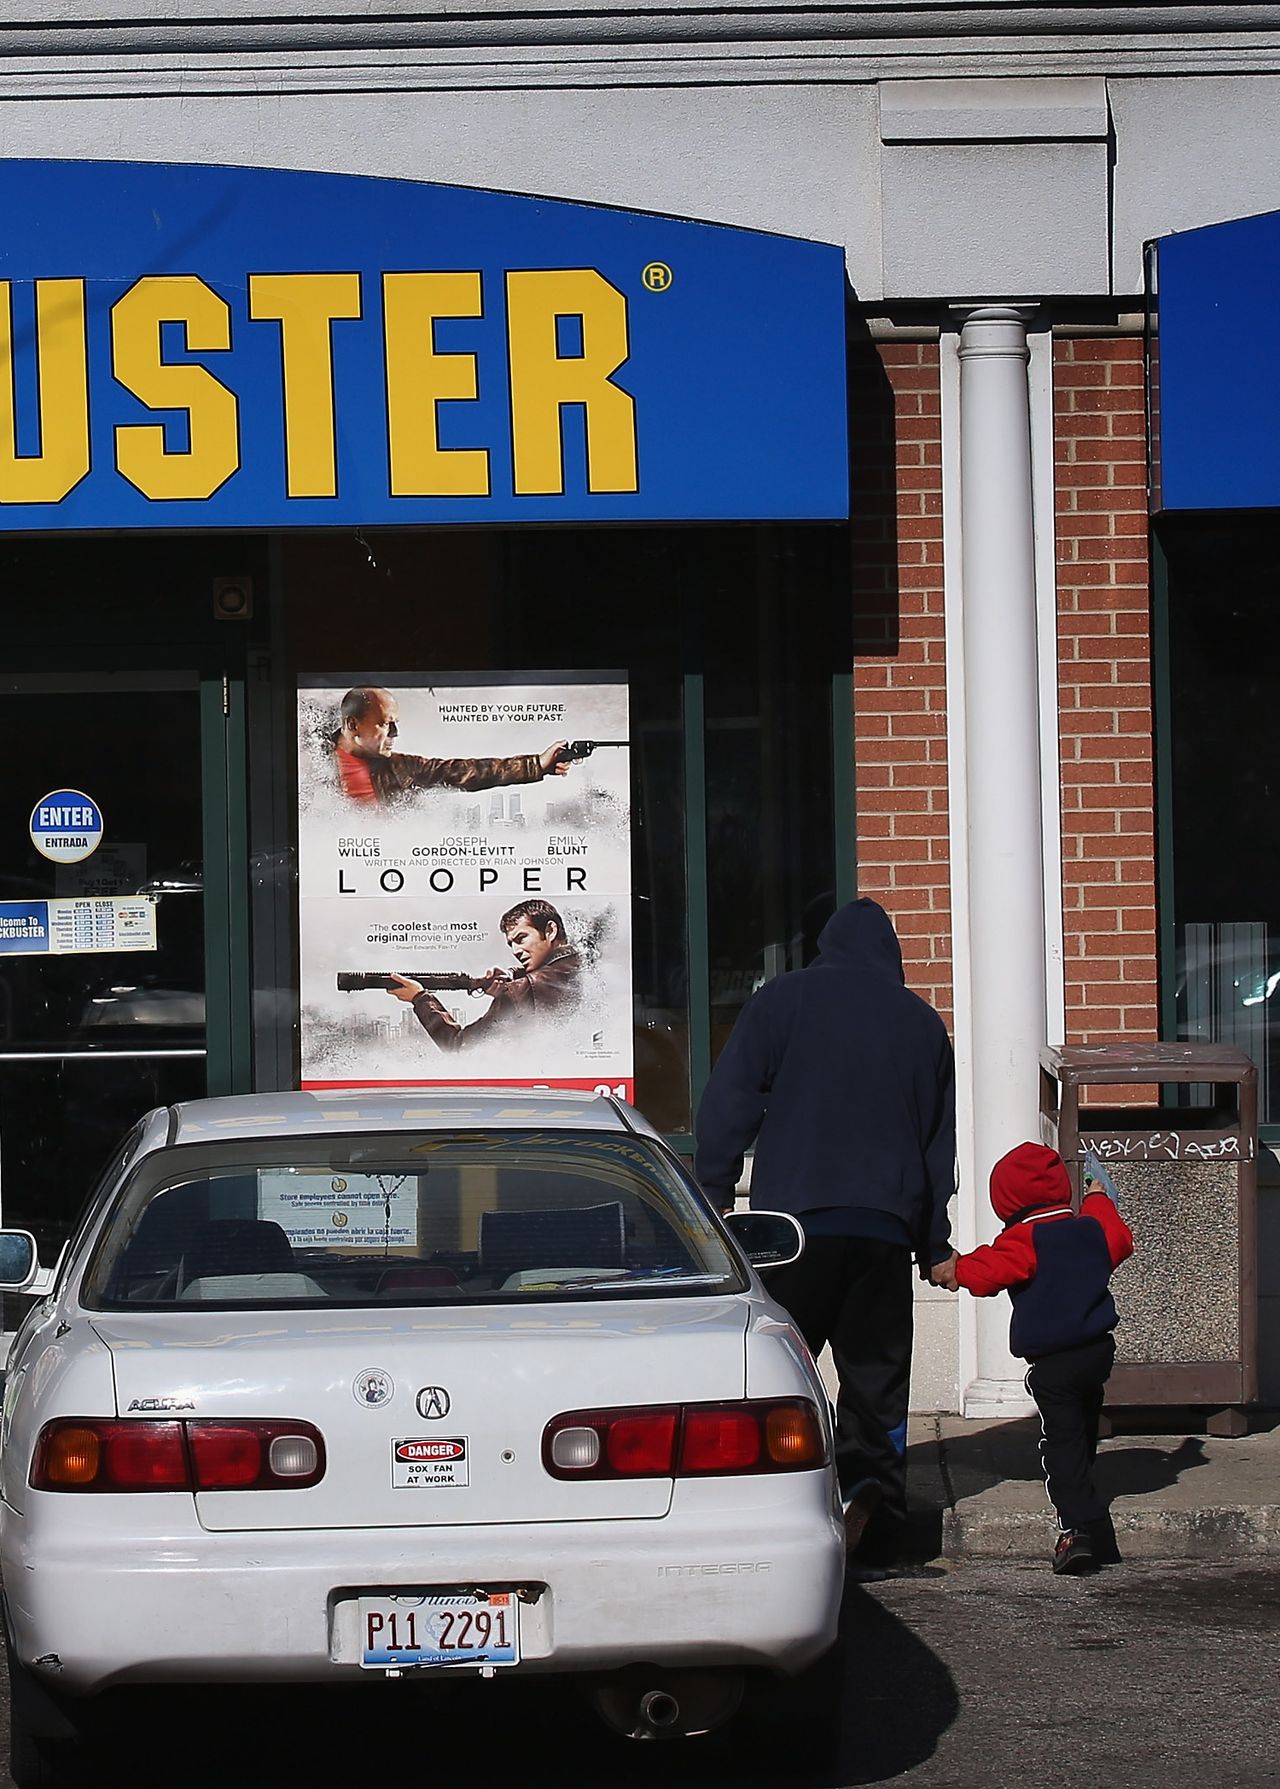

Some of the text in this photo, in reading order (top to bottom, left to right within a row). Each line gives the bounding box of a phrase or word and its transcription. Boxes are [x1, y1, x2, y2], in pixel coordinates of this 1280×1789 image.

[439, 705, 478, 713] HUNTED
[526, 704, 567, 712] FUTURE.
[492, 714, 504, 722] BY
[507, 714, 535, 722] YOUR
[537, 713, 564, 721] PAST.
[39, 807, 93, 826] ENTER
[45, 838, 88, 847] ENTRADA
[338, 836, 586, 848] BRUCE JOSEPH EMILY
[338, 846, 588, 857] WILLIS GORDON-LEVITT BLUNT
[365, 859, 406, 867] WRITTEN
[431, 858, 477, 866] DIRECTED
[479, 858, 492, 866] BY
[338, 867, 588, 893] LOOPER
[28, 916, 39, 926] To
[391, 922, 431, 931] coolest
[432, 923, 448, 931] and
[450, 921, 478, 931] most
[367, 933, 408, 943] original
[300, 1193, 335, 1201] employees
[128, 1399, 195, 1411] ACURA
[408, 1445, 454, 1456] DANGER
[408, 1465, 428, 1473] SOX
[425, 1475, 455, 1483] WORK
[657, 1561, 772, 1577] INTEGRA
[368, 1610, 511, 1650] P11 2291
